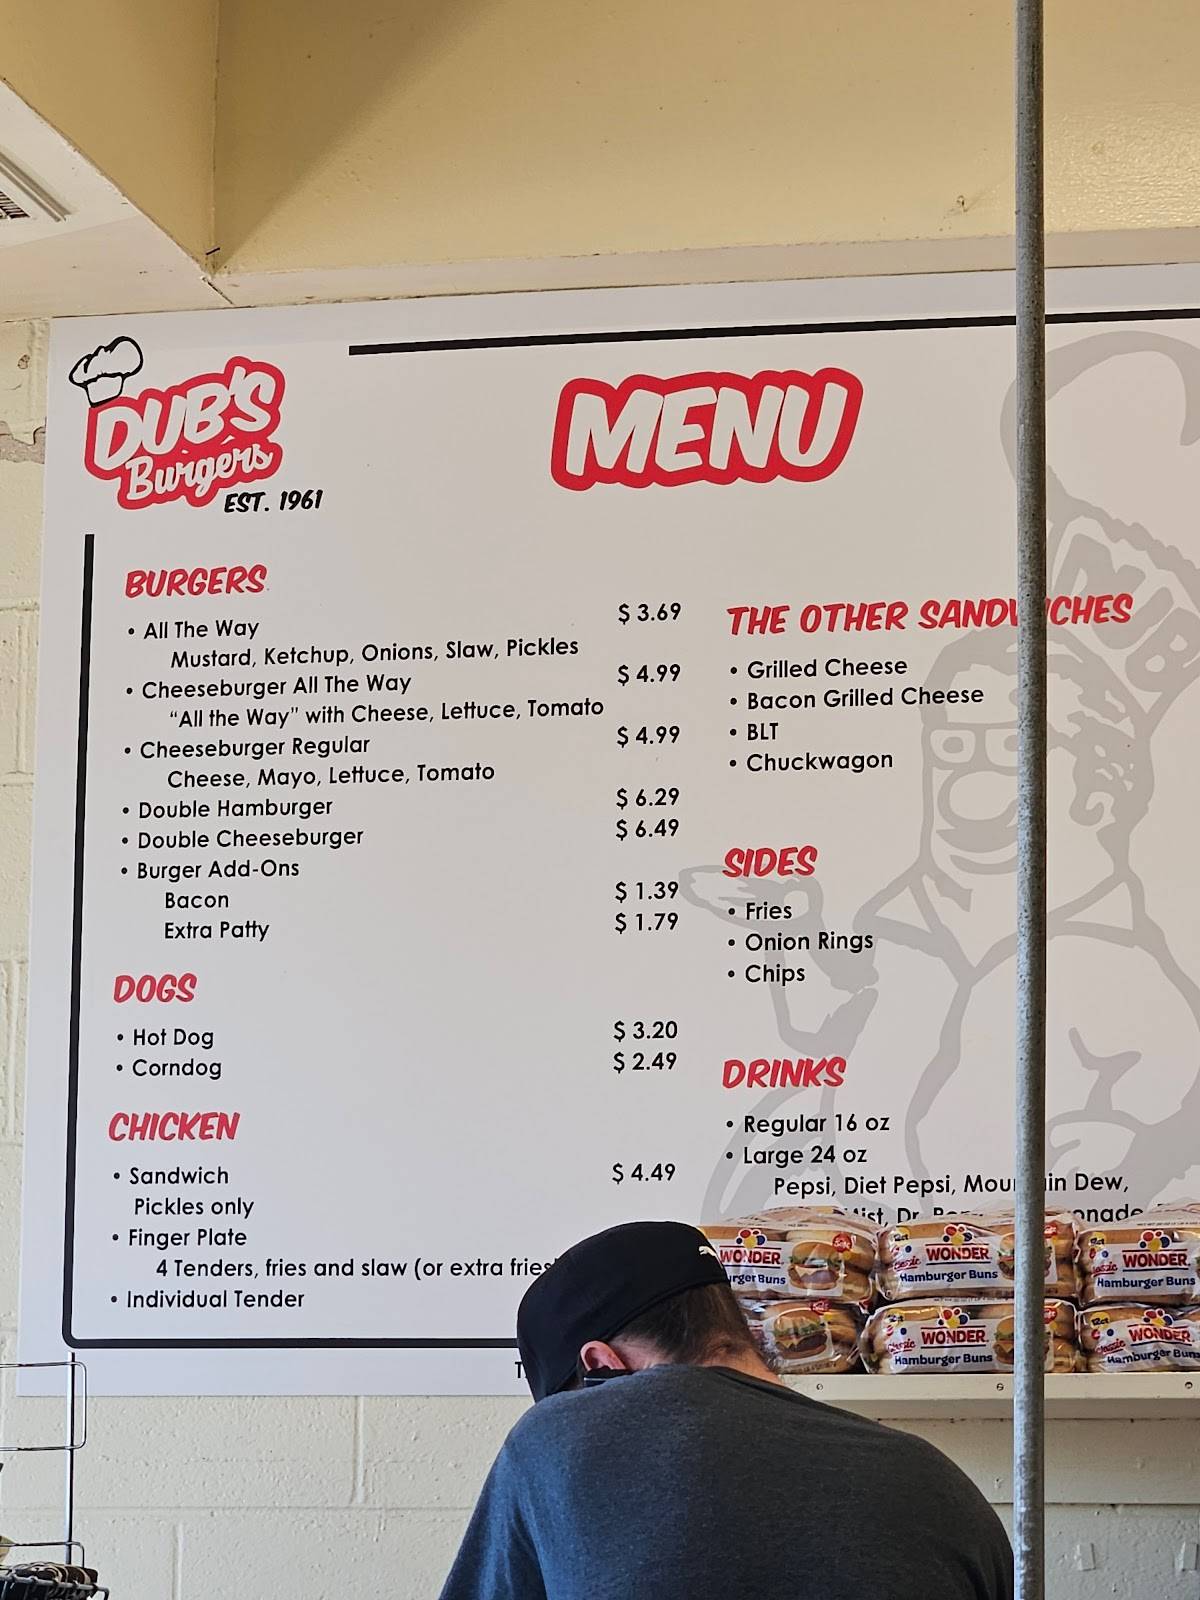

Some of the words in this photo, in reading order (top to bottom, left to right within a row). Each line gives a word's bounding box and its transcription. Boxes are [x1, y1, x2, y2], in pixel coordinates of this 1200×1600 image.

[94, 366, 276, 471] DUB'S
[566, 382, 849, 477] MENU
[126, 444, 274, 500] Burgers
[224, 491, 270, 513] EST.
[279, 489, 323, 510] 1961
[126, 565, 267, 598] BURGERS
[638, 603, 681, 621] 3.69
[729, 605, 789, 634] THE
[800, 601, 909, 632] OTHER
[920, 594, 1133, 629] SANDCHES
[144, 622, 168, 639] All
[175, 621, 208, 638] The
[216, 620, 259, 640] Way
[171, 648, 257, 668] Mustard,
[265, 646, 353, 666] Ketchup,
[362, 642, 438, 661] Onions,
[446, 641, 499, 659] Slaw,
[507, 637, 579, 656] Pickles
[637, 664, 680, 682] 4.99
[748, 658, 816, 678] Grilled
[825, 658, 907, 676] Cheese
[143, 679, 286, 699] Cheeseburger
[293, 676, 317, 694] All
[325, 675, 359, 692] The
[367, 674, 411, 694] Way
[748, 693, 815, 710] Bacon
[824, 688, 893, 707] Grilled
[901, 687, 984, 705] Cheese
[209, 709, 239, 726] the
[306, 706, 344, 723] with
[352, 704, 434, 722] Cheese,
[442, 701, 521, 719] Lettuce,
[528, 698, 604, 717] Tomato
[636, 726, 680, 744] 4.99
[748, 723, 778, 740] BLT
[140, 740, 285, 760] Cheeseburger
[293, 736, 370, 758] Regular
[747, 753, 892, 773] Chuckwagon
[168, 770, 250, 788] Cheese,
[258, 769, 321, 789] Mayo,
[329, 766, 410, 785] Lettuce,
[417, 763, 495, 781] Tomato
[636, 788, 679, 806] 6.29
[139, 800, 210, 818] Double
[218, 799, 333, 820] Hamburger
[636, 819, 679, 837] 6.49
[138, 831, 209, 848] Double
[217, 828, 363, 850] Cheeseburger
[138, 861, 202, 882] Burger
[208, 859, 300, 877] Add-Ons
[724, 845, 817, 878] SIDES
[166, 892, 229, 908] Bacon
[636, 881, 678, 899] 1.39
[747, 902, 792, 920] Fries
[165, 922, 212, 939] Extra
[220, 921, 269, 943] Patty
[636, 913, 678, 931] 1.79
[746, 932, 809, 951] Onion
[819, 931, 874, 953] Rings
[746, 964, 806, 986] Chips
[114, 973, 197, 1003] DOGS
[134, 1029, 166, 1045] Hot
[174, 1029, 214, 1050] Dog
[633, 1021, 677, 1039] 3.20
[133, 1058, 222, 1080] Corndog
[632, 1052, 676, 1070] 2.49
[723, 1056, 846, 1088] DRINKS
[109, 1112, 239, 1141] CHICKEN
[744, 1114, 827, 1137] Regular
[835, 1114, 857, 1131] 16
[866, 1117, 889, 1131] oz
[744, 1147, 803, 1168] Large
[811, 1145, 835, 1163] 24
[843, 1149, 867, 1163] oz
[130, 1166, 229, 1184] Sandwich
[631, 1163, 675, 1181] 4.49
[774, 1176, 836, 1199] Pepsi,
[845, 1176, 886, 1194] Diet
[894, 1175, 955, 1197] Pepsi,
[963, 1173, 1067, 1194] Mouin
[1075, 1173, 1129, 1192] Dew,
[135, 1197, 203, 1215] Pickles
[211, 1197, 254, 1219] only
[129, 1228, 190, 1250] Finger
[197, 1228, 247, 1246] Plate
[720, 1249, 782, 1264] WONDER
[926, 1247, 990, 1261] WONDER
[1122, 1253, 1188, 1268] WONDER
[156, 1259, 167, 1276] 4
[174, 1258, 259, 1279] Tenders,
[266, 1258, 307, 1277] fries
[314, 1258, 353, 1276] and
[362, 1258, 407, 1276] slaw
[415, 1258, 443, 1280] (or
[451, 1258, 503, 1277] extra
[511, 1257, 558, 1276] fries
[901, 1271, 966, 1283] Hamburger
[969, 1269, 998, 1279] Buns
[758, 1274, 786, 1285] Buns
[1097, 1278, 1164, 1290] Hamburger
[1166, 1276, 1195, 1286] Buns
[128, 1289, 226, 1308] Individual
[234, 1289, 304, 1308] Tender
[921, 1330, 986, 1345] WONDER
[1128, 1328, 1191, 1343] WONDER
[895, 1355, 960, 1367] Hamburger
[963, 1353, 993, 1363] Buns
[1107, 1349, 1171, 1364] Hamburger
